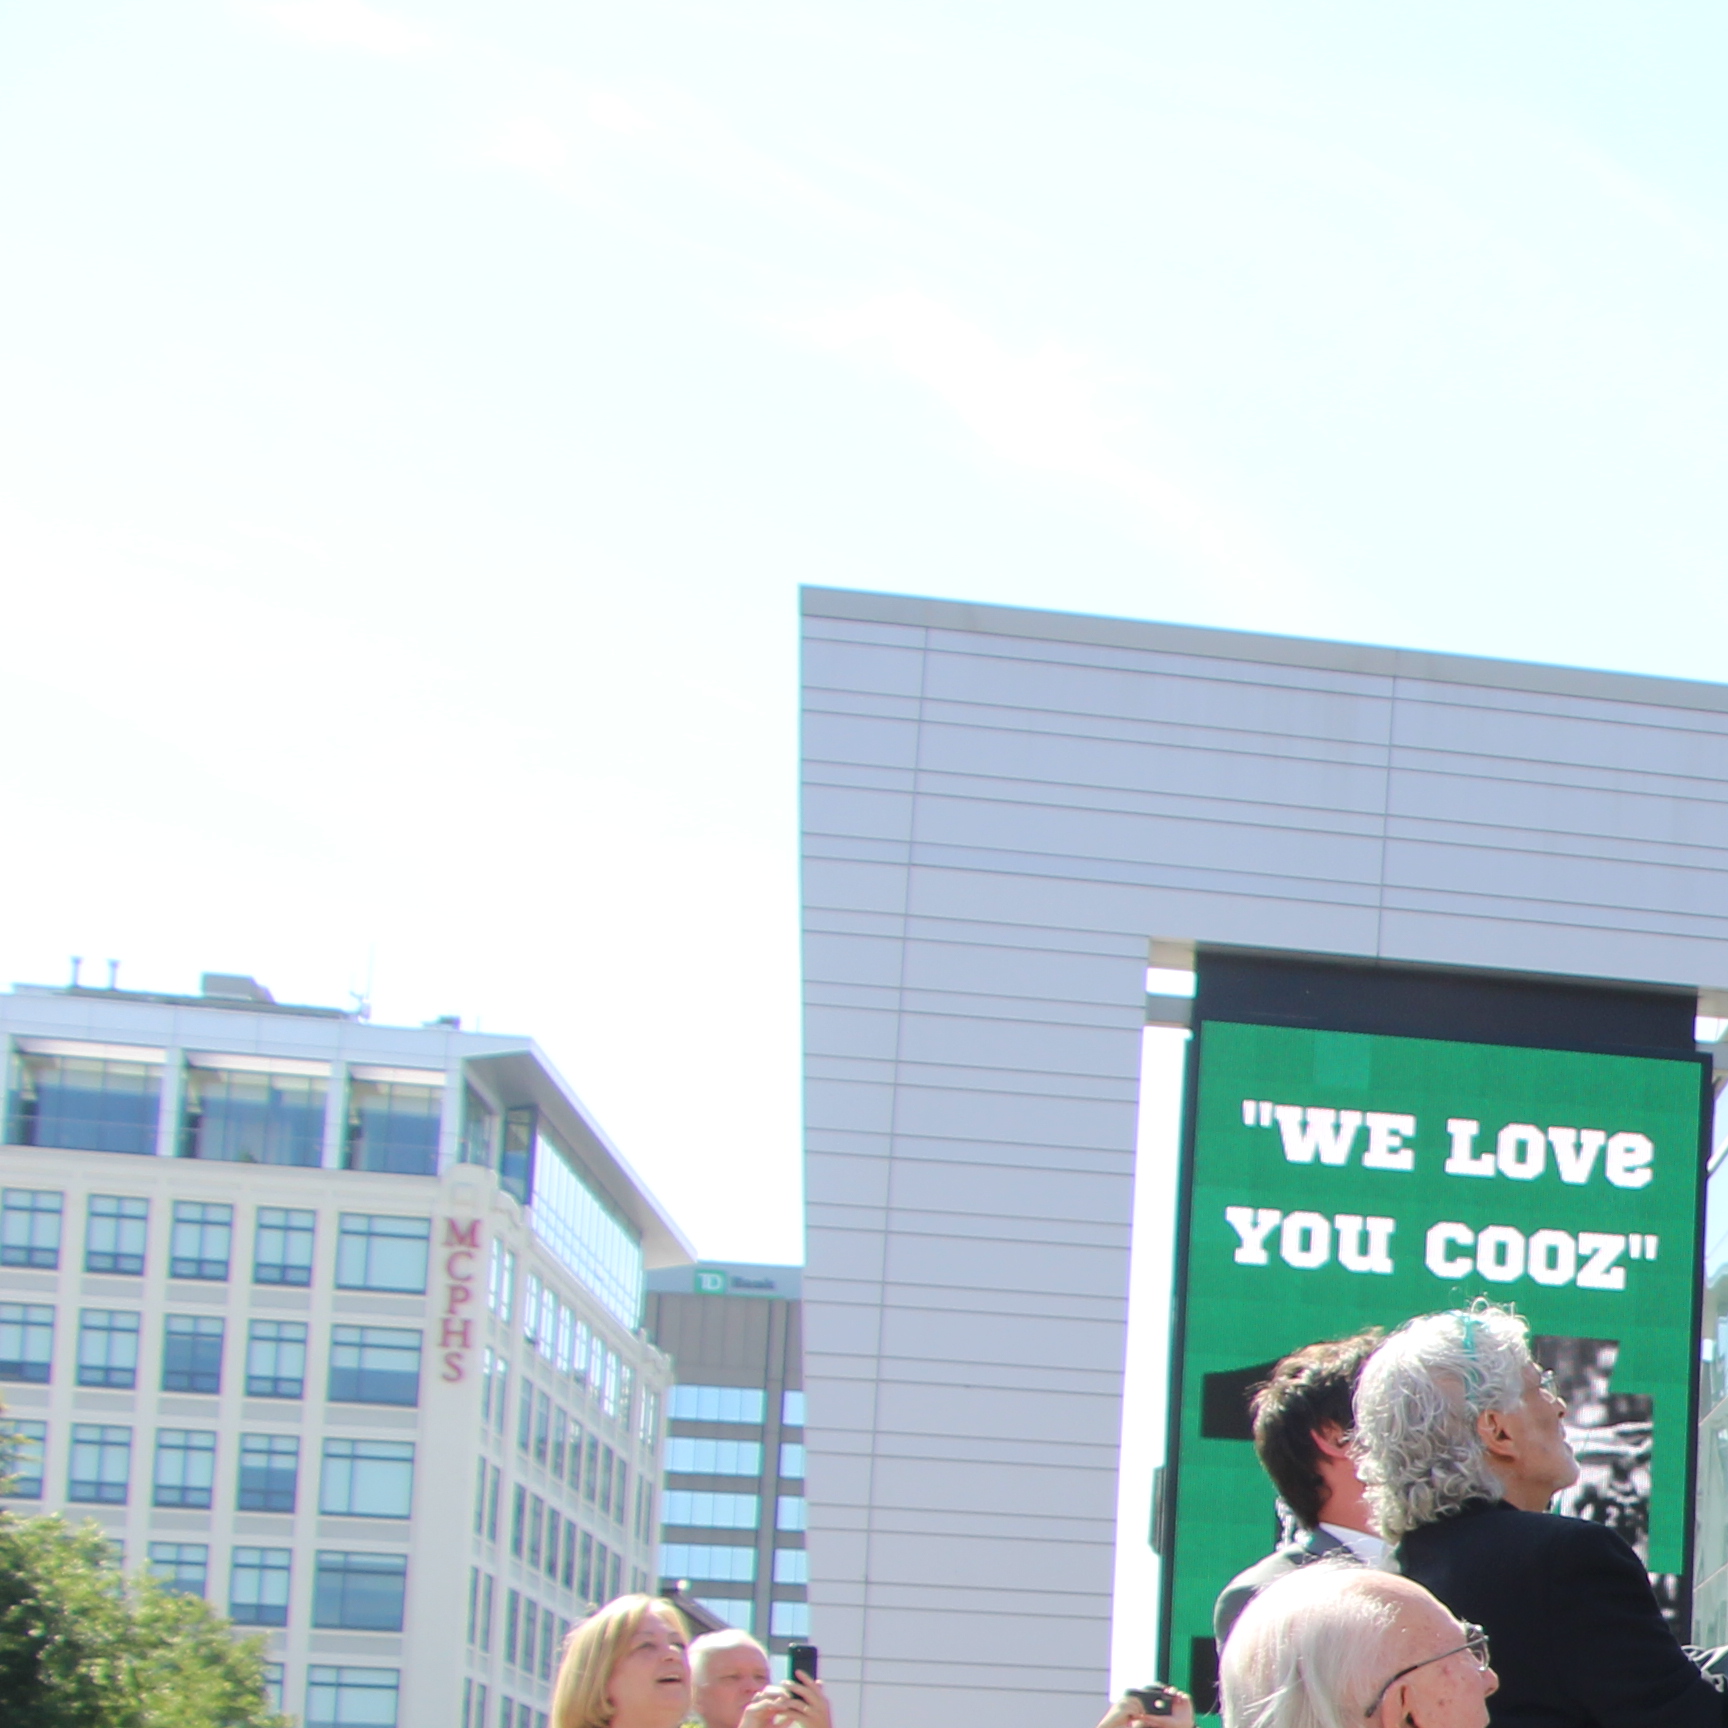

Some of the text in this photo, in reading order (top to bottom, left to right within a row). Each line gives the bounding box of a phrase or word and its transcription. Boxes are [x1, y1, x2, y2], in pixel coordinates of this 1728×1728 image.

[1242, 1099, 1417, 1171] "WE
[698, 1273, 722, 1291] TD
[1225, 1206, 1659, 1291] YOU COOZ"
[439, 1217, 482, 1383] MCPHS
